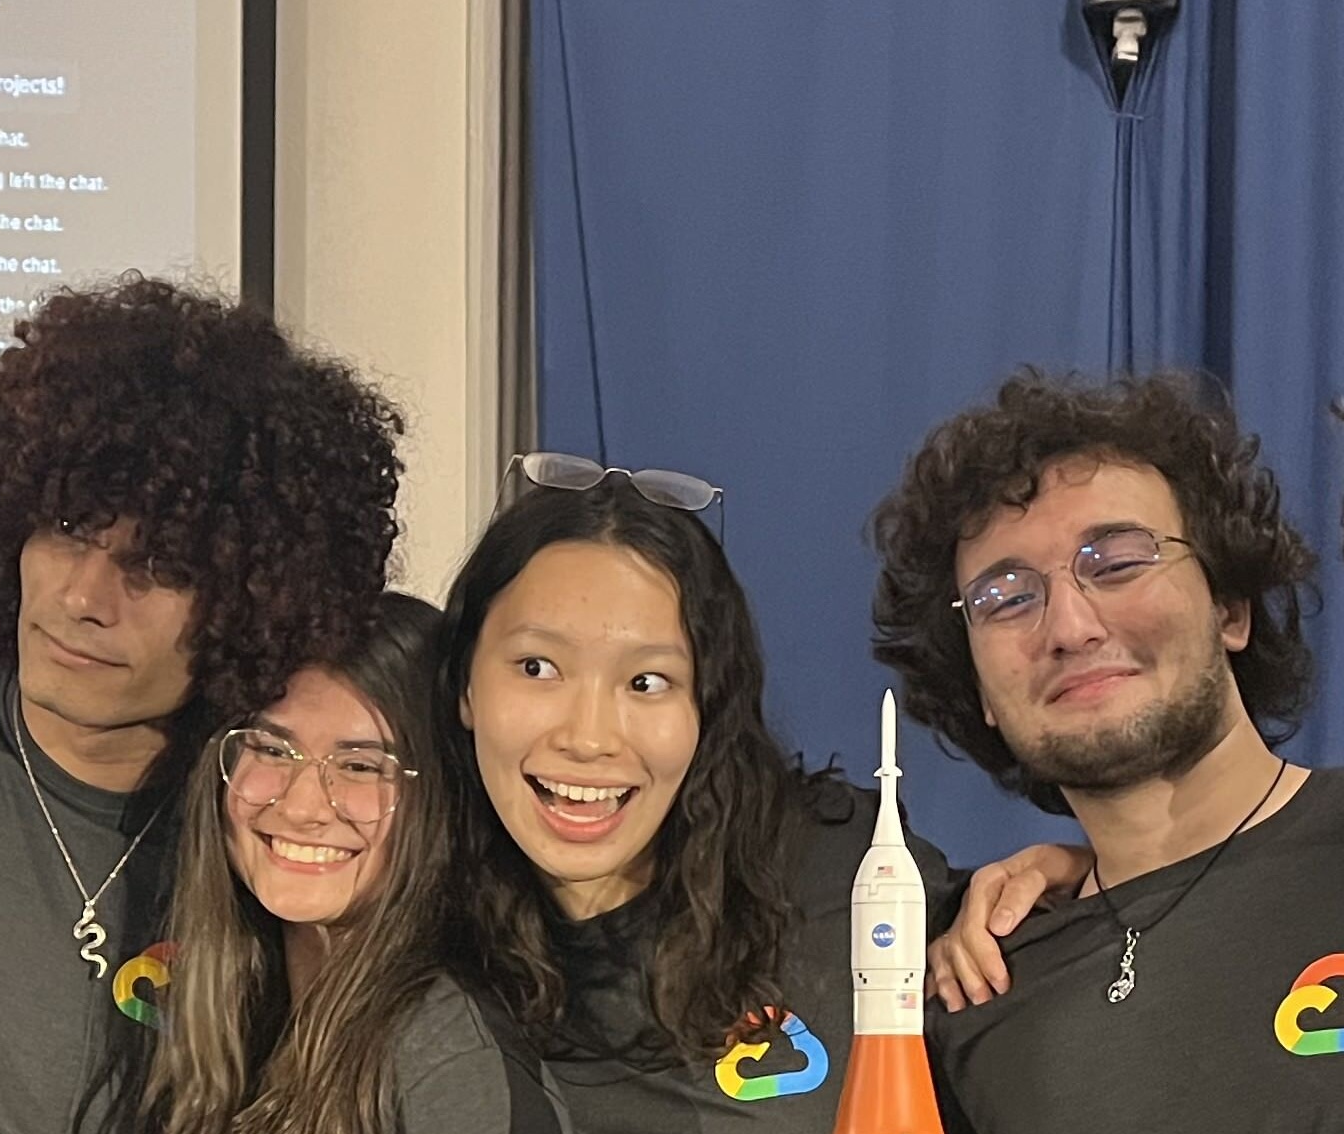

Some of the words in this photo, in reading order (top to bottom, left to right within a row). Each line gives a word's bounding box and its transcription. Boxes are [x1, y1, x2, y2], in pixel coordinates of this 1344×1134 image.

[9, 171, 36, 189] left
[39, 173, 65, 190] the
[69, 173, 109, 191] chat.
[24, 214, 64, 232] chat.
[22, 257, 63, 274] chat.
